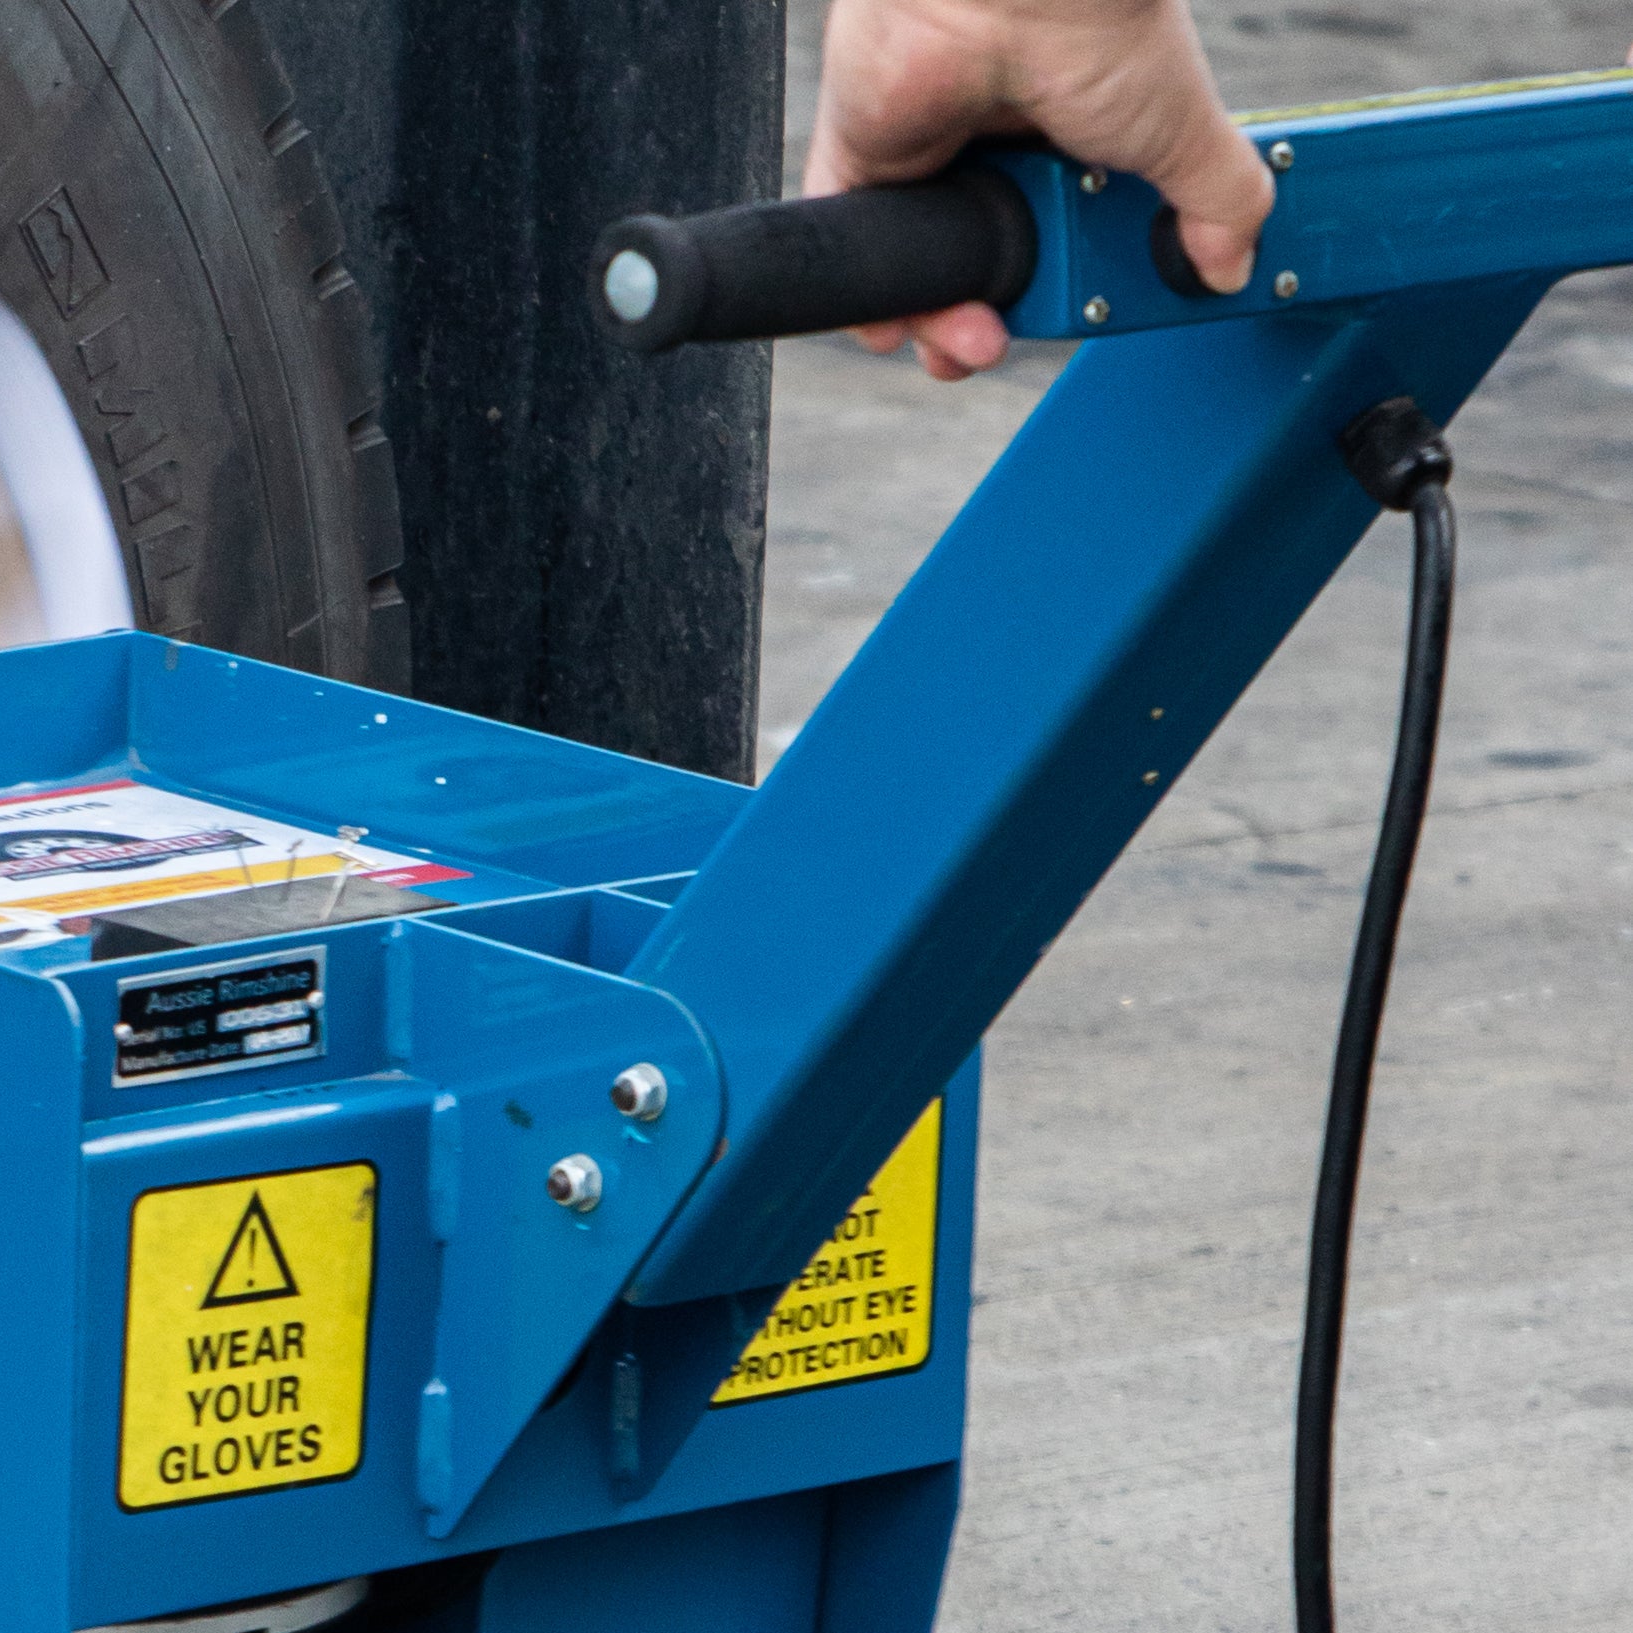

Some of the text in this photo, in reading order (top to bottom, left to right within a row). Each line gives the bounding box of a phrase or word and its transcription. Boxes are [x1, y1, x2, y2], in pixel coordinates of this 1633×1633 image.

[66, 831, 235, 865] RIMSHIN
[145, 970, 312, 1015] Aussie Rimshine
[866, 1285, 918, 1321] EYE
[186, 1320, 306, 1375] WEAR
[726, 1328, 909, 1388] PROTECTION
[186, 1375, 301, 1428] YOUR
[158, 1423, 323, 1485] GLOVES
